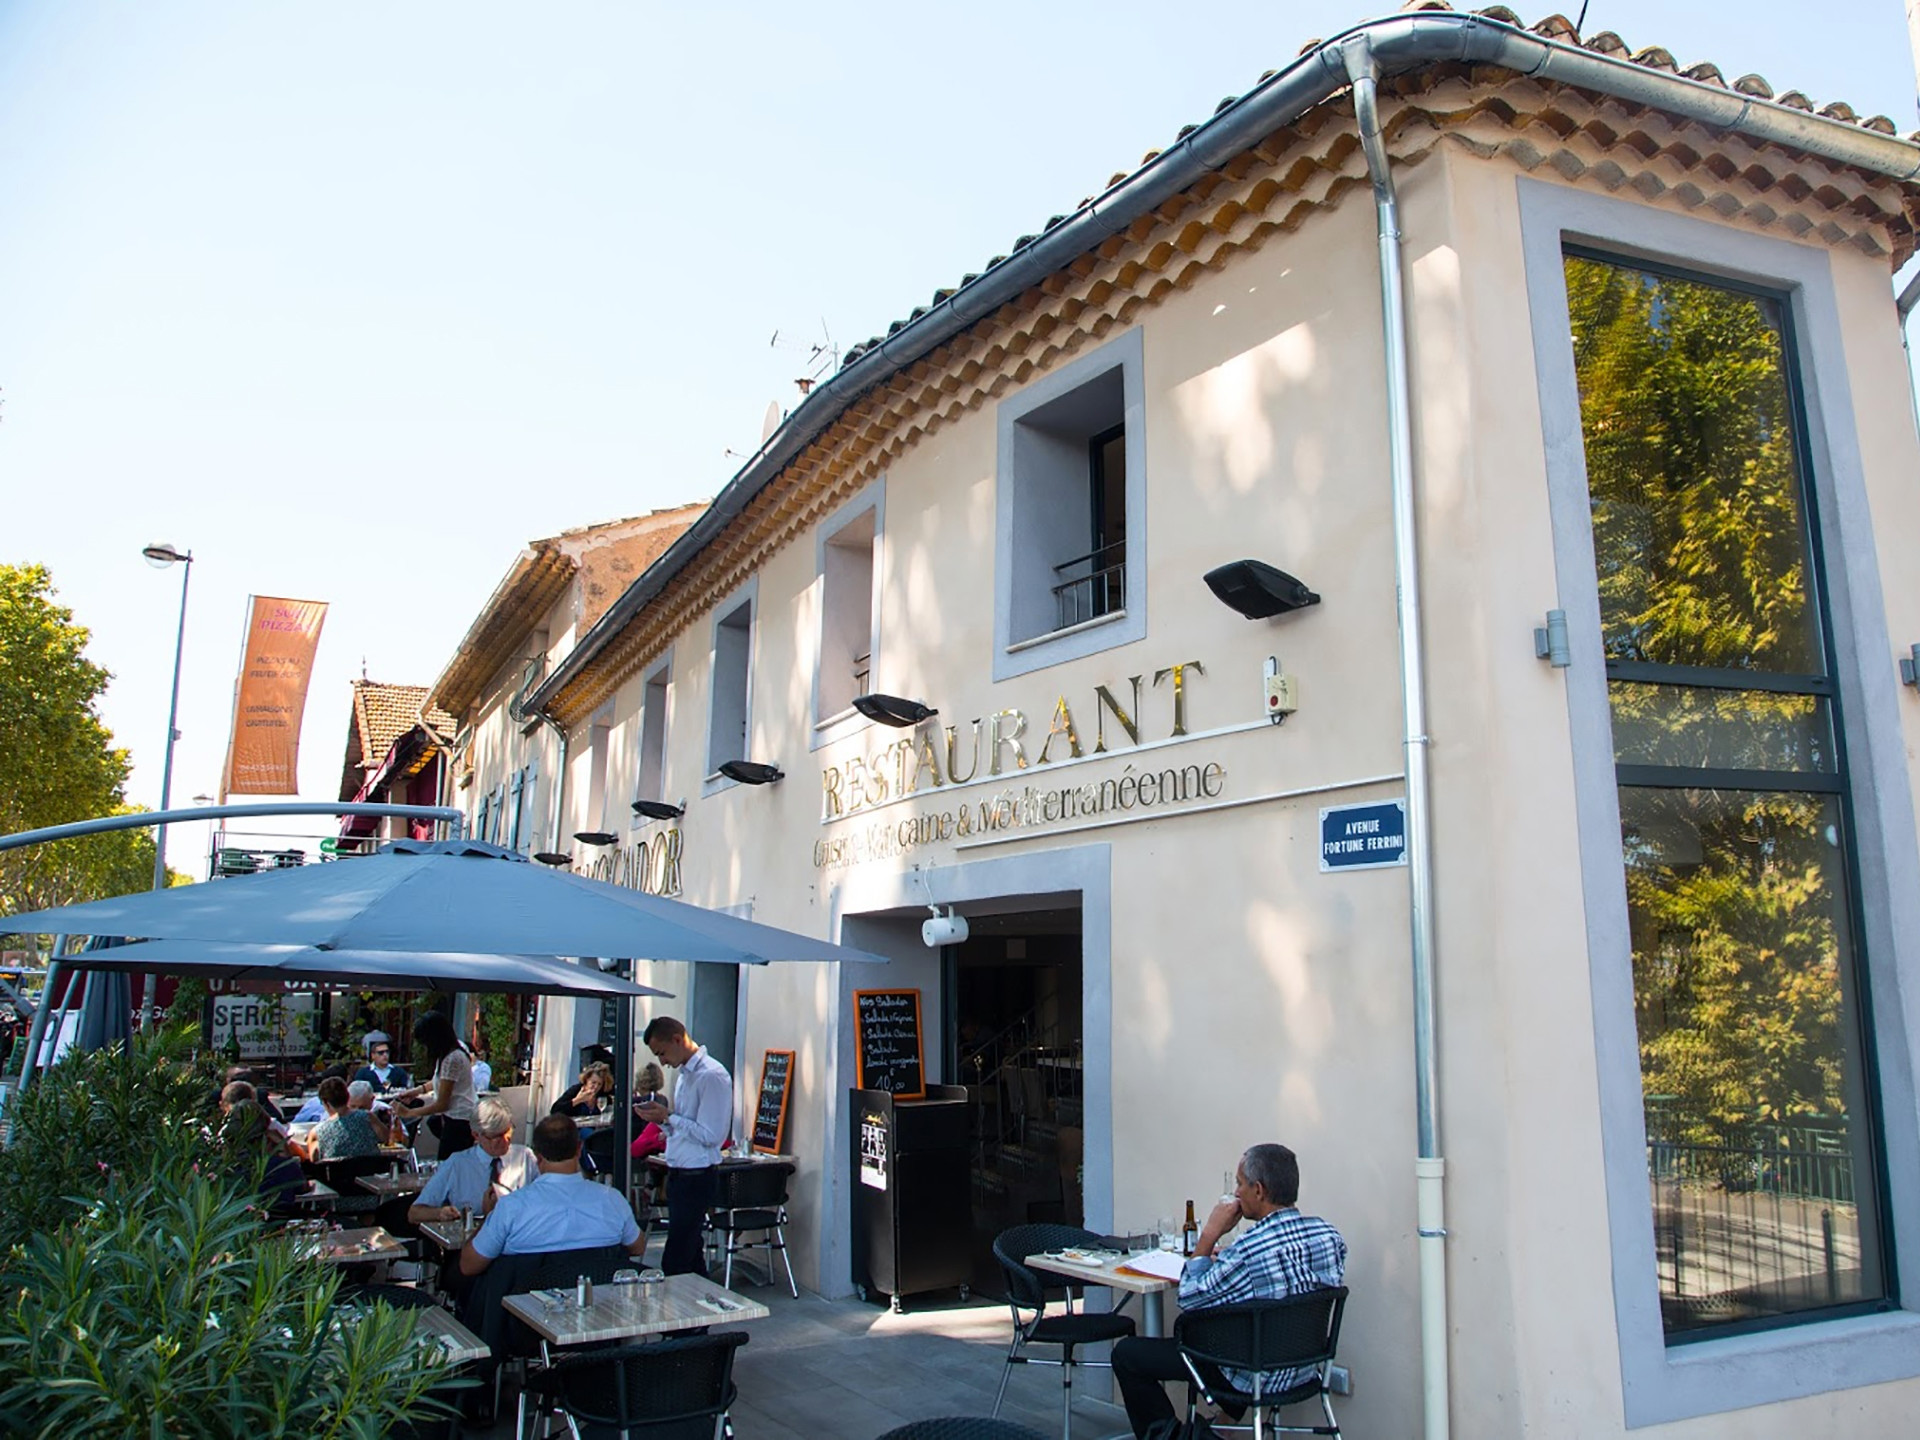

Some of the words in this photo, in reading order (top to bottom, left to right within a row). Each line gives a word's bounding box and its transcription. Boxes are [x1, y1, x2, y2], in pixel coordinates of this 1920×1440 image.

[820, 659, 1205, 819] RESTAURANT
[956, 803, 972, 836] &
[976, 760, 1224, 834] Méditerranéenne
[1323, 838, 1365, 855] FORTUNE
[1366, 834, 1404, 851] FERRINI
[1344, 818, 1381, 836] AVENUE
